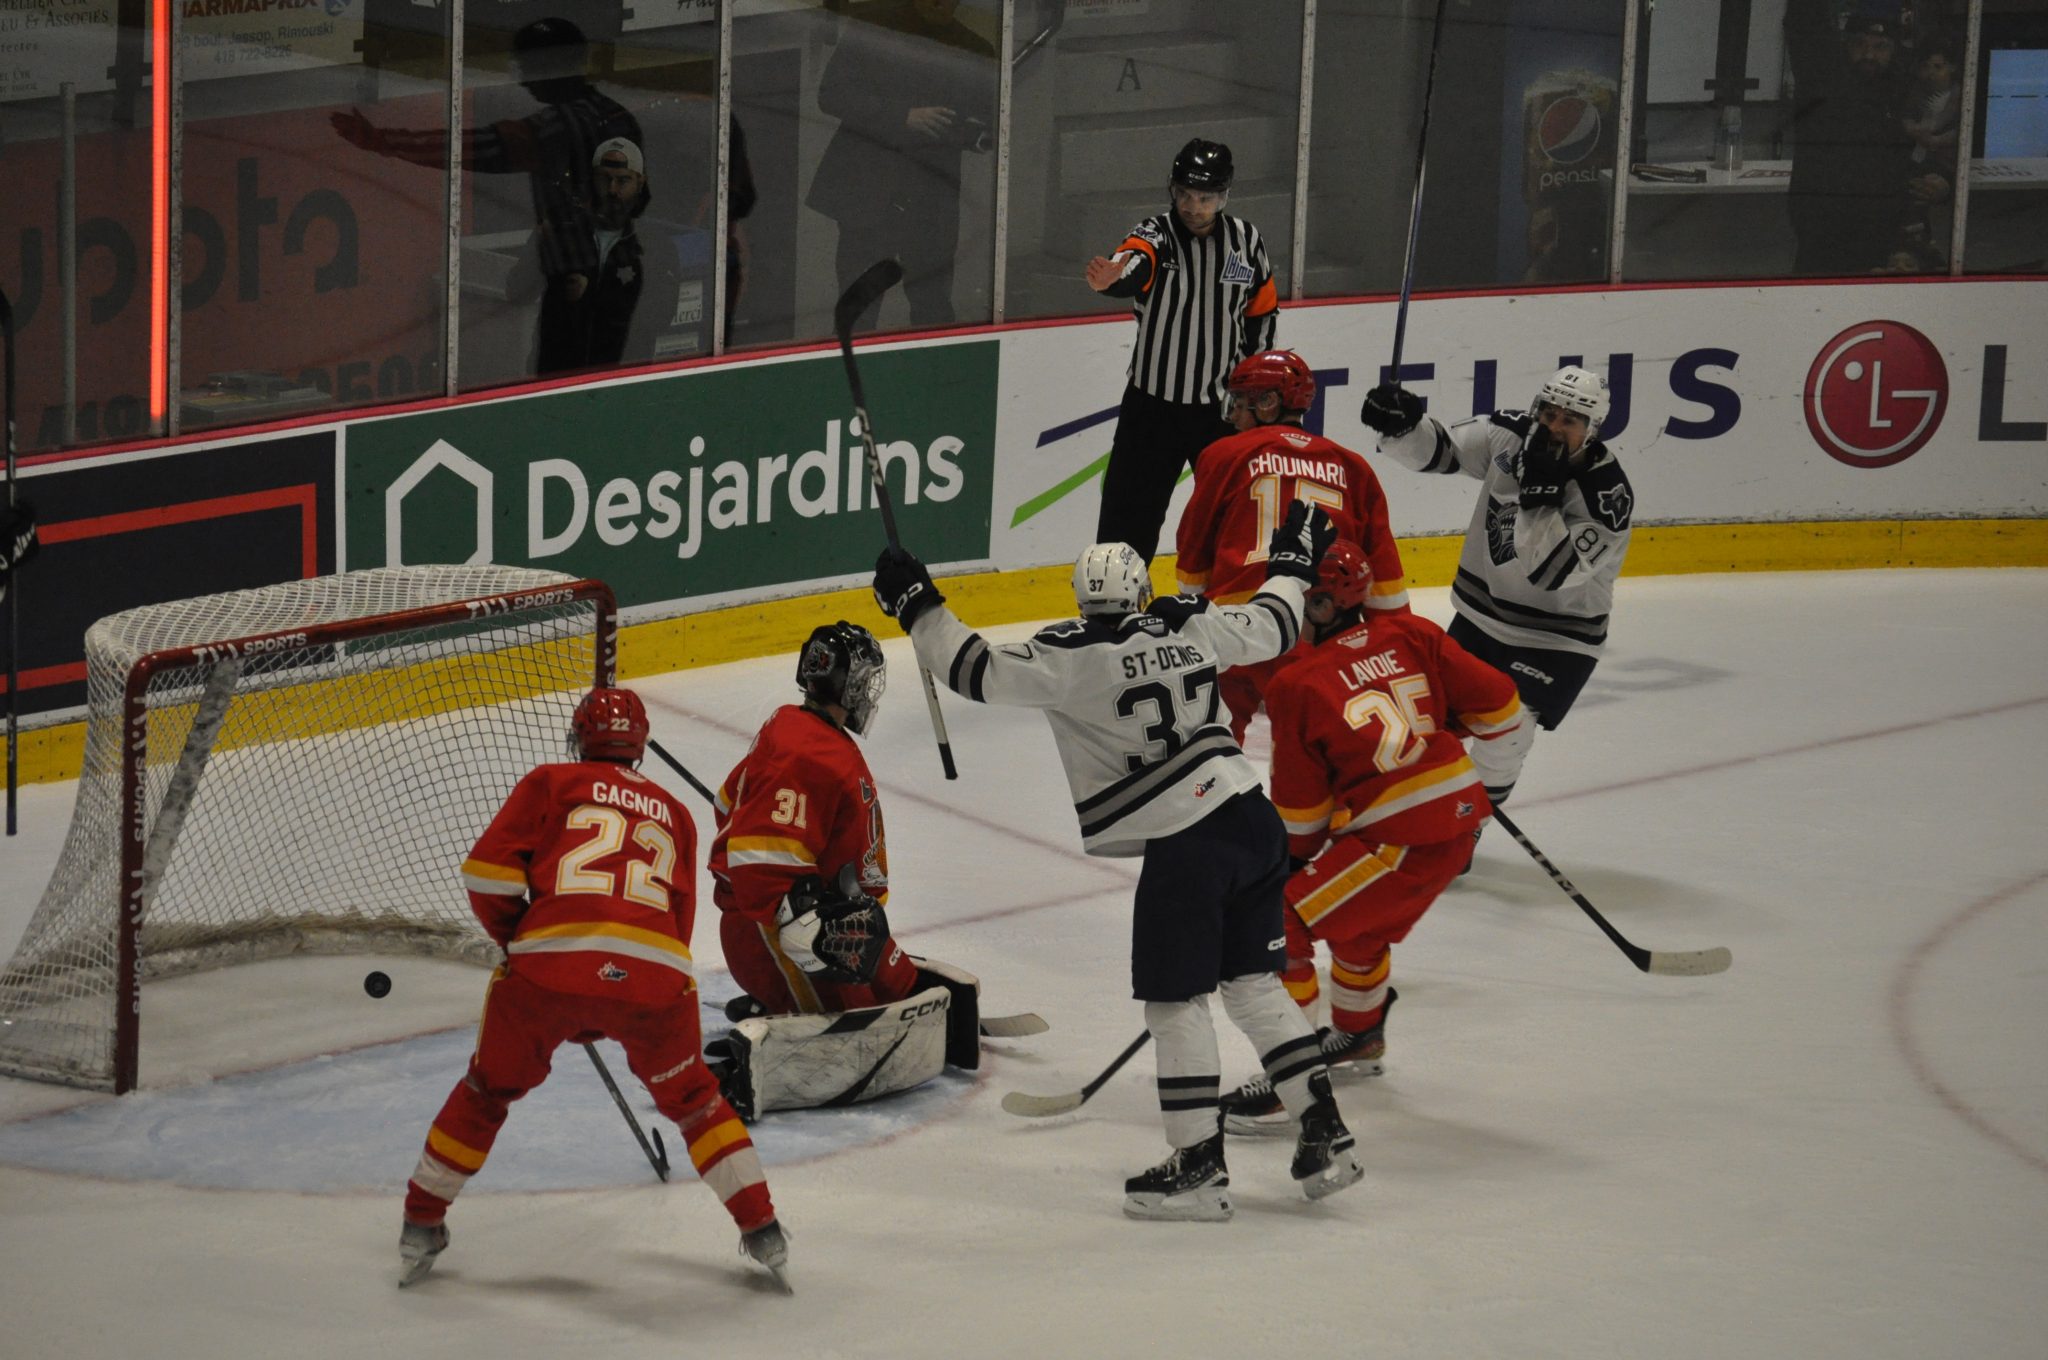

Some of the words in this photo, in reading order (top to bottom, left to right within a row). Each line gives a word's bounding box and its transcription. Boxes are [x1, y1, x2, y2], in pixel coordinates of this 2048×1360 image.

[278, 22, 334, 40] Rimouski
[528, 419, 966, 561] Desjardins
[1248, 453, 1347, 489] CHOUINARD
[1089, 579, 1104, 593] 37
[243, 632, 307, 656] SPORTS
[1338, 649, 1406, 691] LAVOIE
[610, 718, 629, 731] 22
[1113, 664, 1220, 774] 37
[1343, 673, 1432, 773] 25
[592, 781, 673, 828] GAGNON
[771, 788, 807, 829] 31
[555, 804, 677, 912] 22
[899, 996, 949, 1021] CCM
